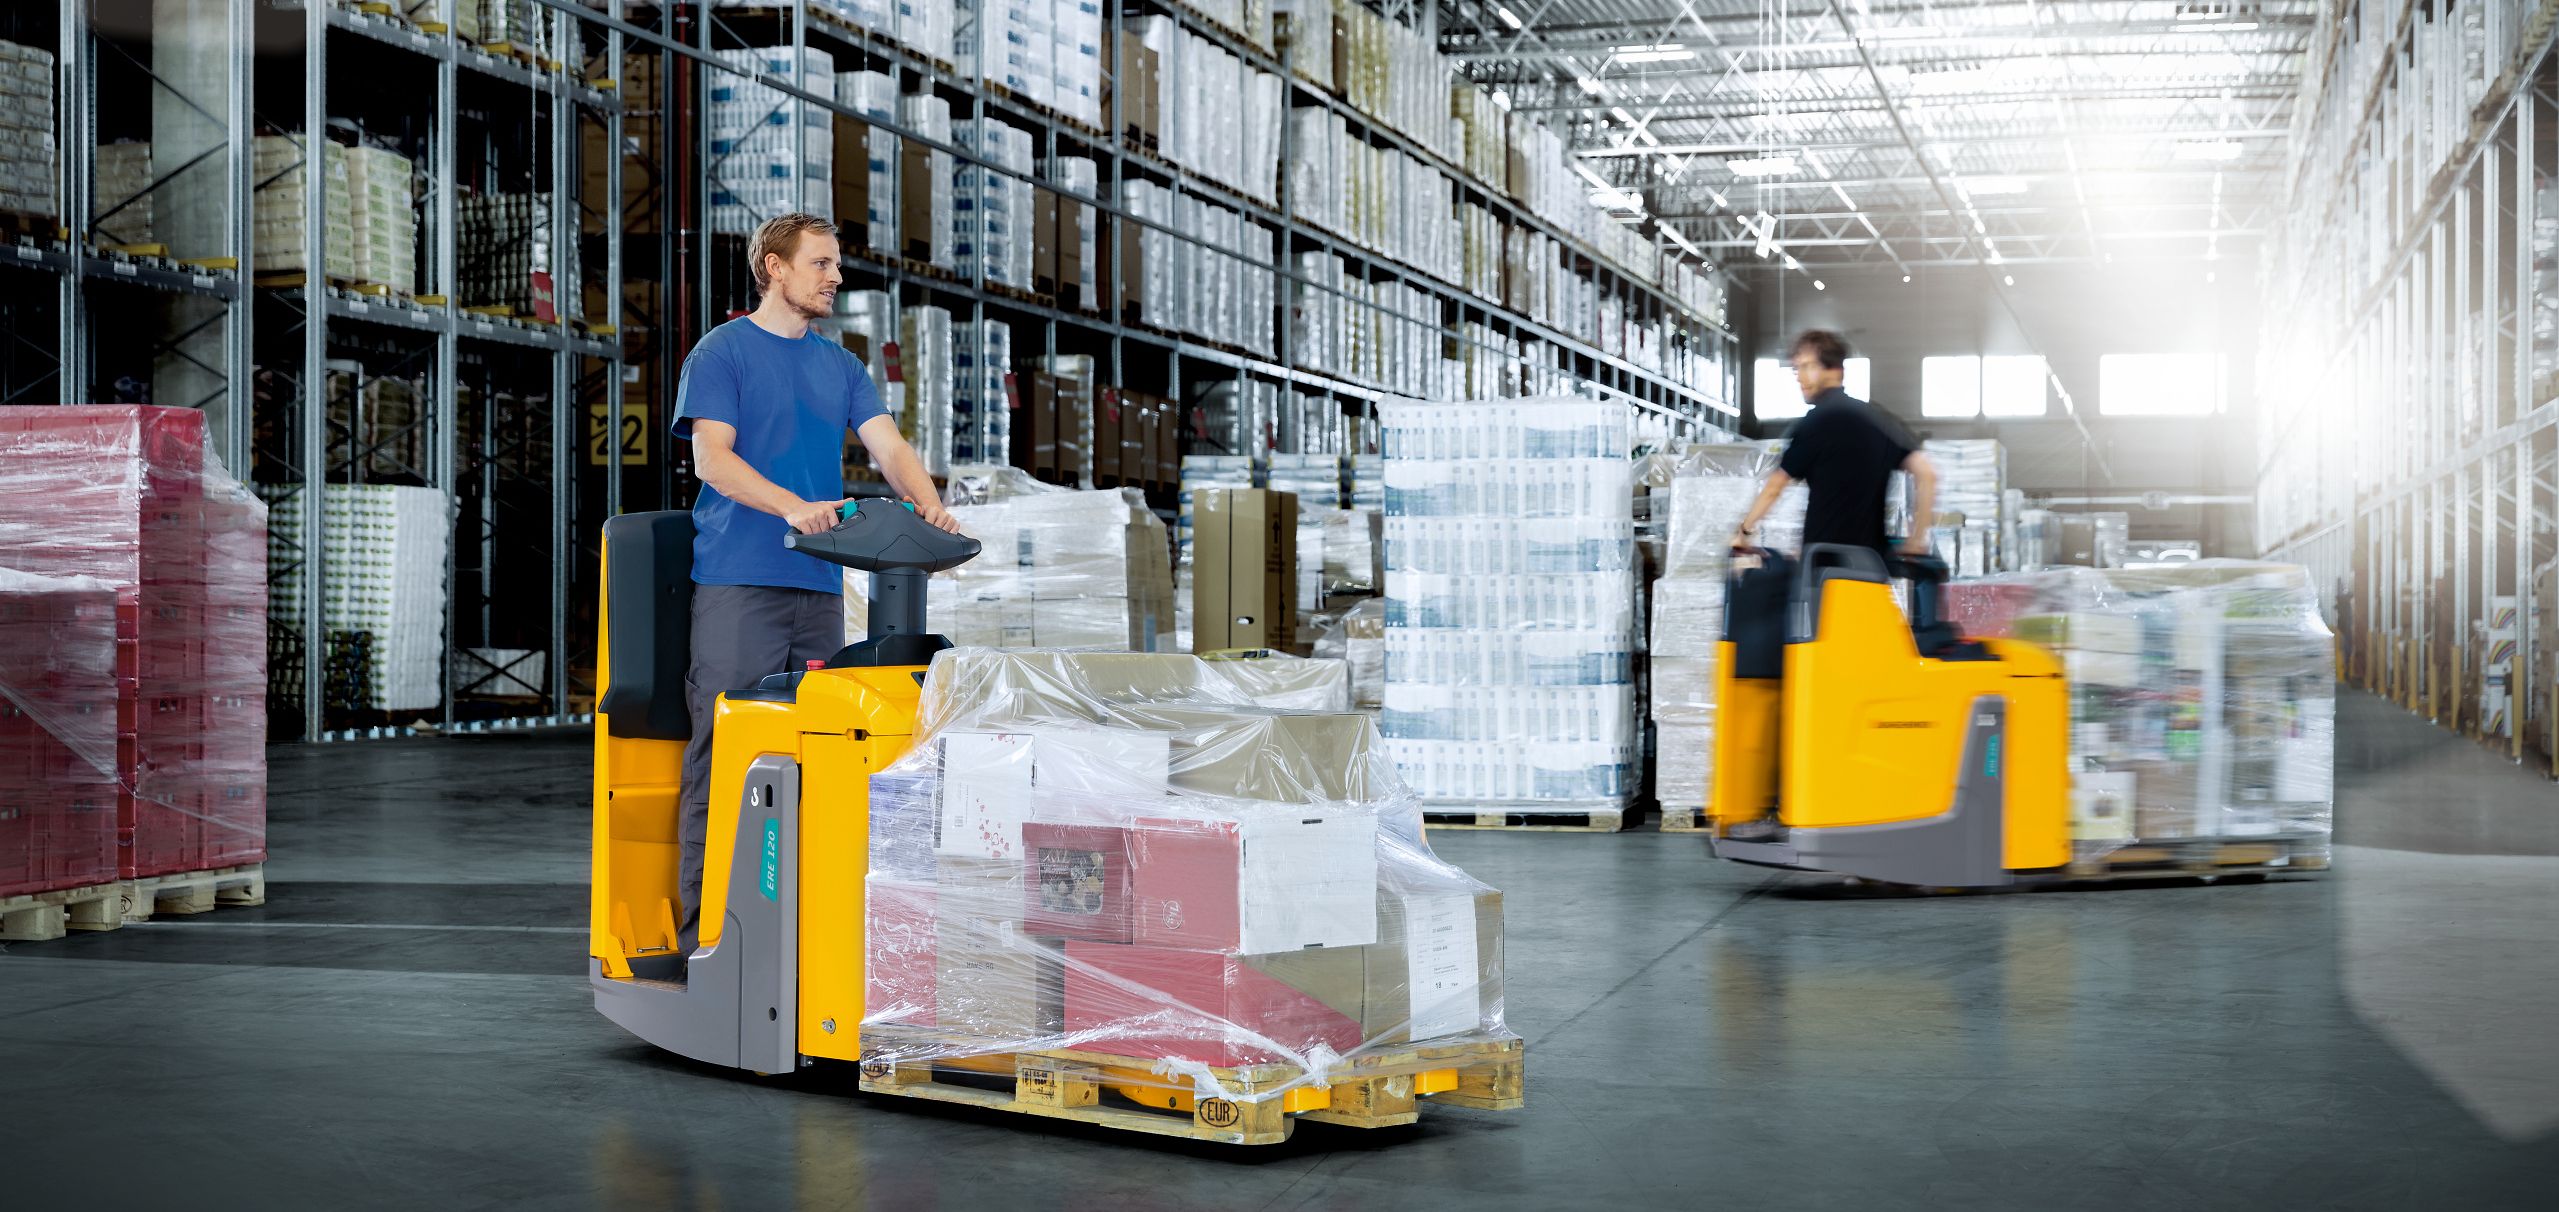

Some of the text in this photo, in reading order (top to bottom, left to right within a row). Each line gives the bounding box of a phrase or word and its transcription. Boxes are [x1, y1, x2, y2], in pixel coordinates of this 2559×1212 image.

[766, 830, 776, 891] ERE 120
[1207, 1101, 1230, 1122] EUR
